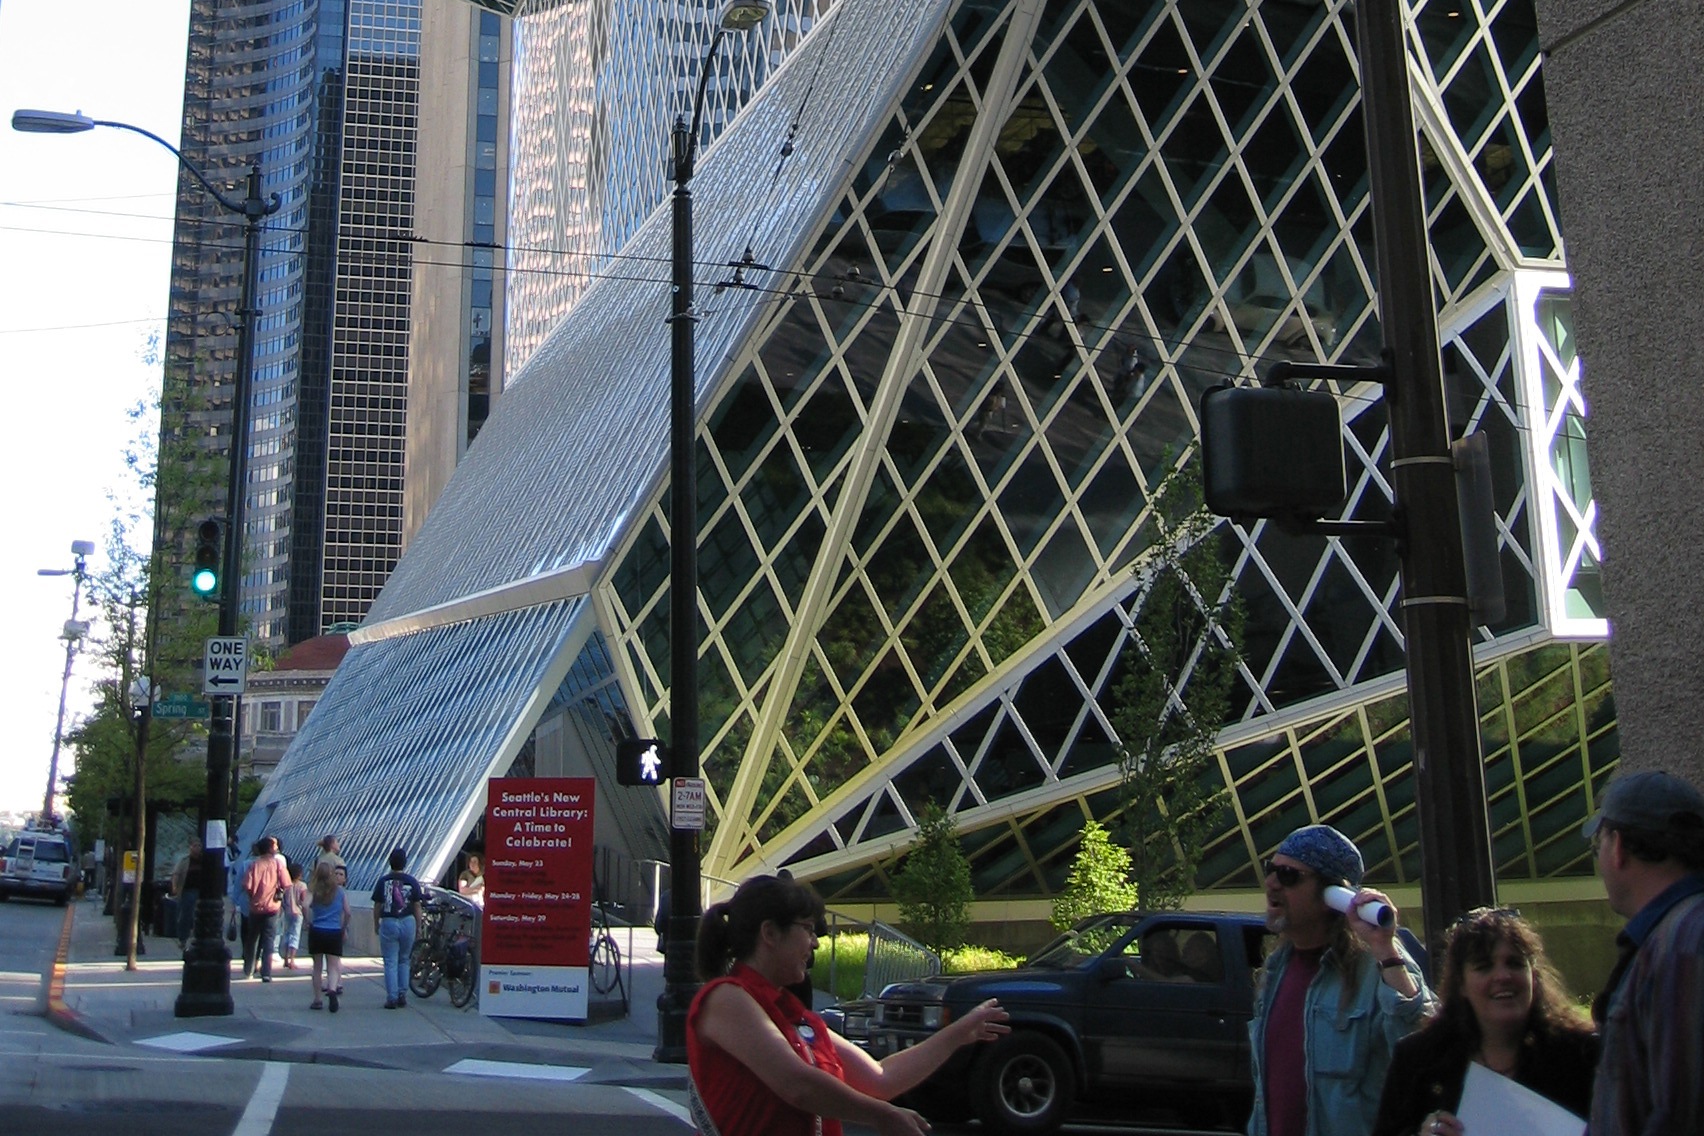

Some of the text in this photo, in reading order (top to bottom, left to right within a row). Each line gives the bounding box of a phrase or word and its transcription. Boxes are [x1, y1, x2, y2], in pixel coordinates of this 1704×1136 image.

[210, 641, 243, 655] ONE
[209, 657, 243, 671] WAY
[155, 703, 187, 717] Spring
[501, 791, 580, 803] Seattle's New
[677, 791, 702, 801] 2-7AM
[492, 806, 588, 820] Central Library:
[513, 821, 566, 833] A Time to
[505, 836, 572, 848] Celebrate!
[492, 859, 518, 868] Sunday,
[518, 860, 534, 869] May
[489, 892, 516, 900] Monday
[521, 892, 544, 901] Friday,
[544, 893, 560, 901] May
[489, 913, 520, 923] Saturday,
[521, 914, 537, 923] May
[502, 983, 580, 994] Washington Mutual
